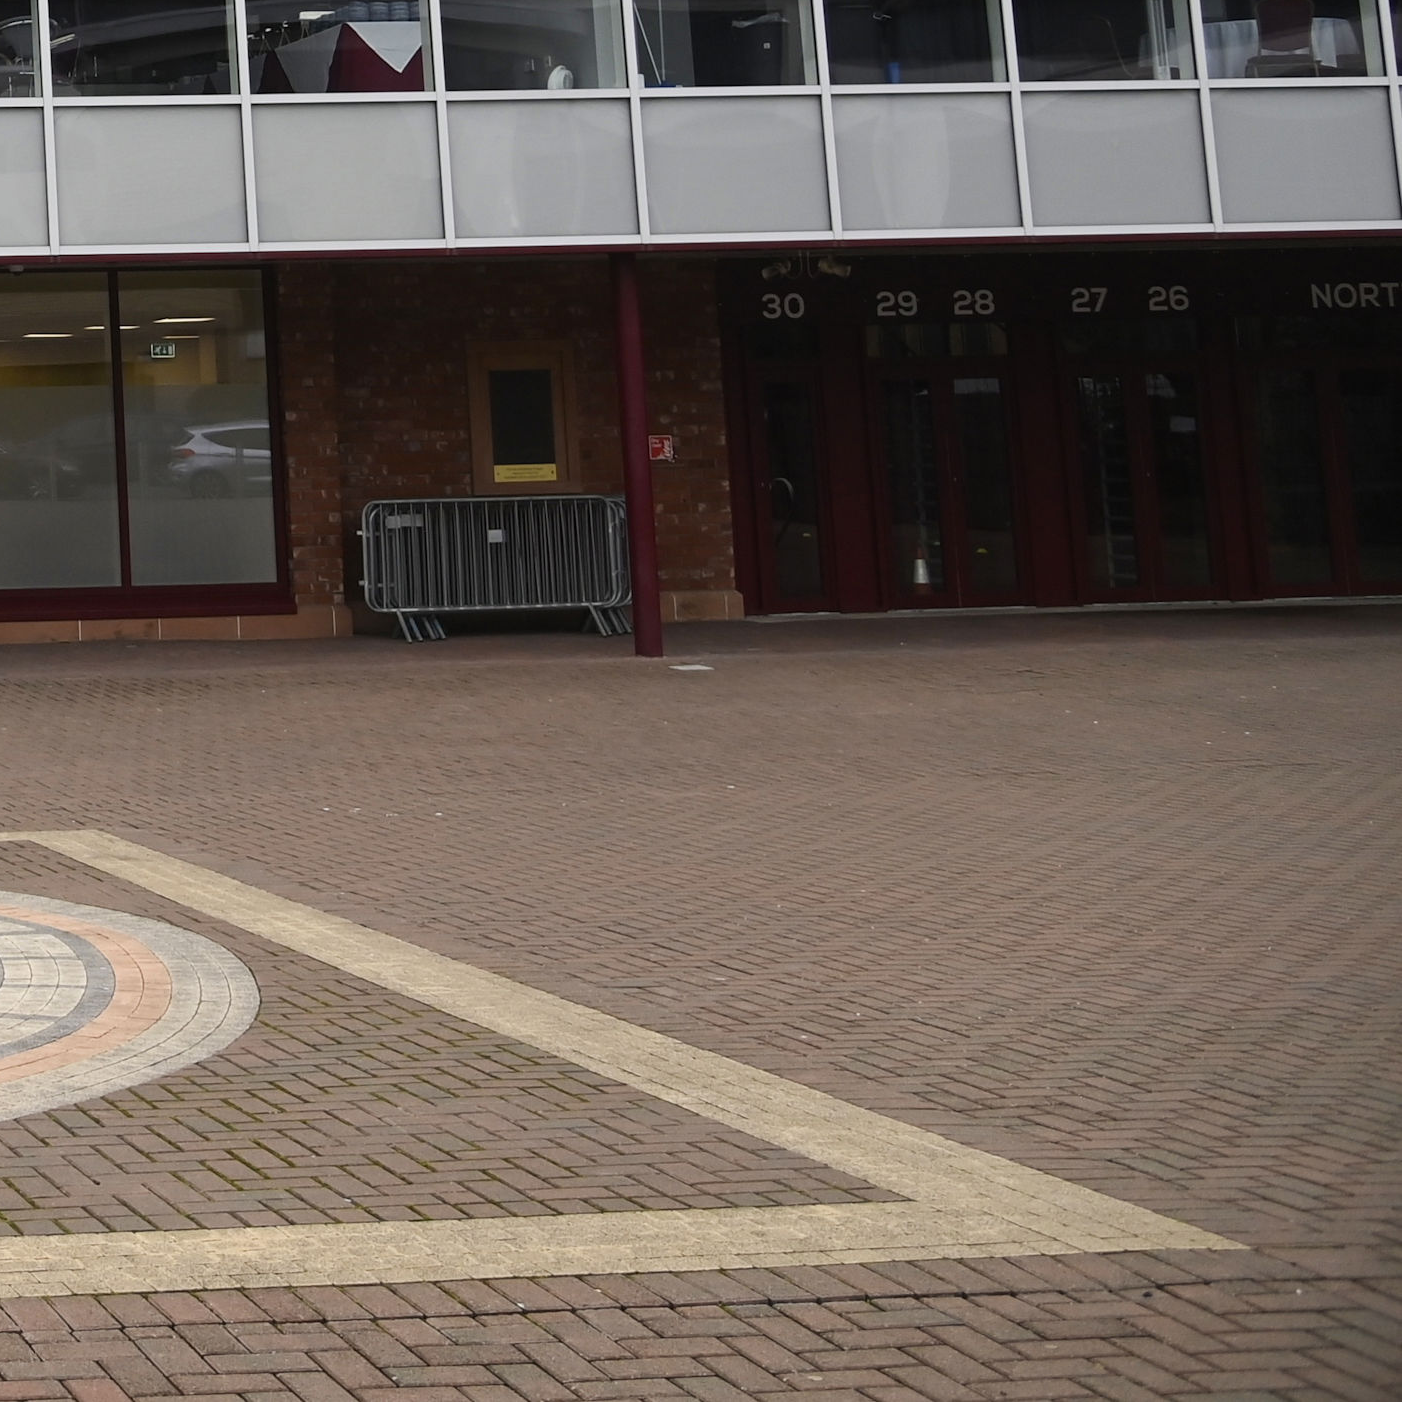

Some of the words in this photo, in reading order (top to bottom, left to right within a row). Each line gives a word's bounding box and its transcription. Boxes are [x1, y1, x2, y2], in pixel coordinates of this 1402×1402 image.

[761, 292, 805, 319] 30
[876, 290, 918, 317] 29
[953, 289, 995, 315] 28
[1071, 287, 1108, 313] 27
[1147, 285, 1189, 311] 26
